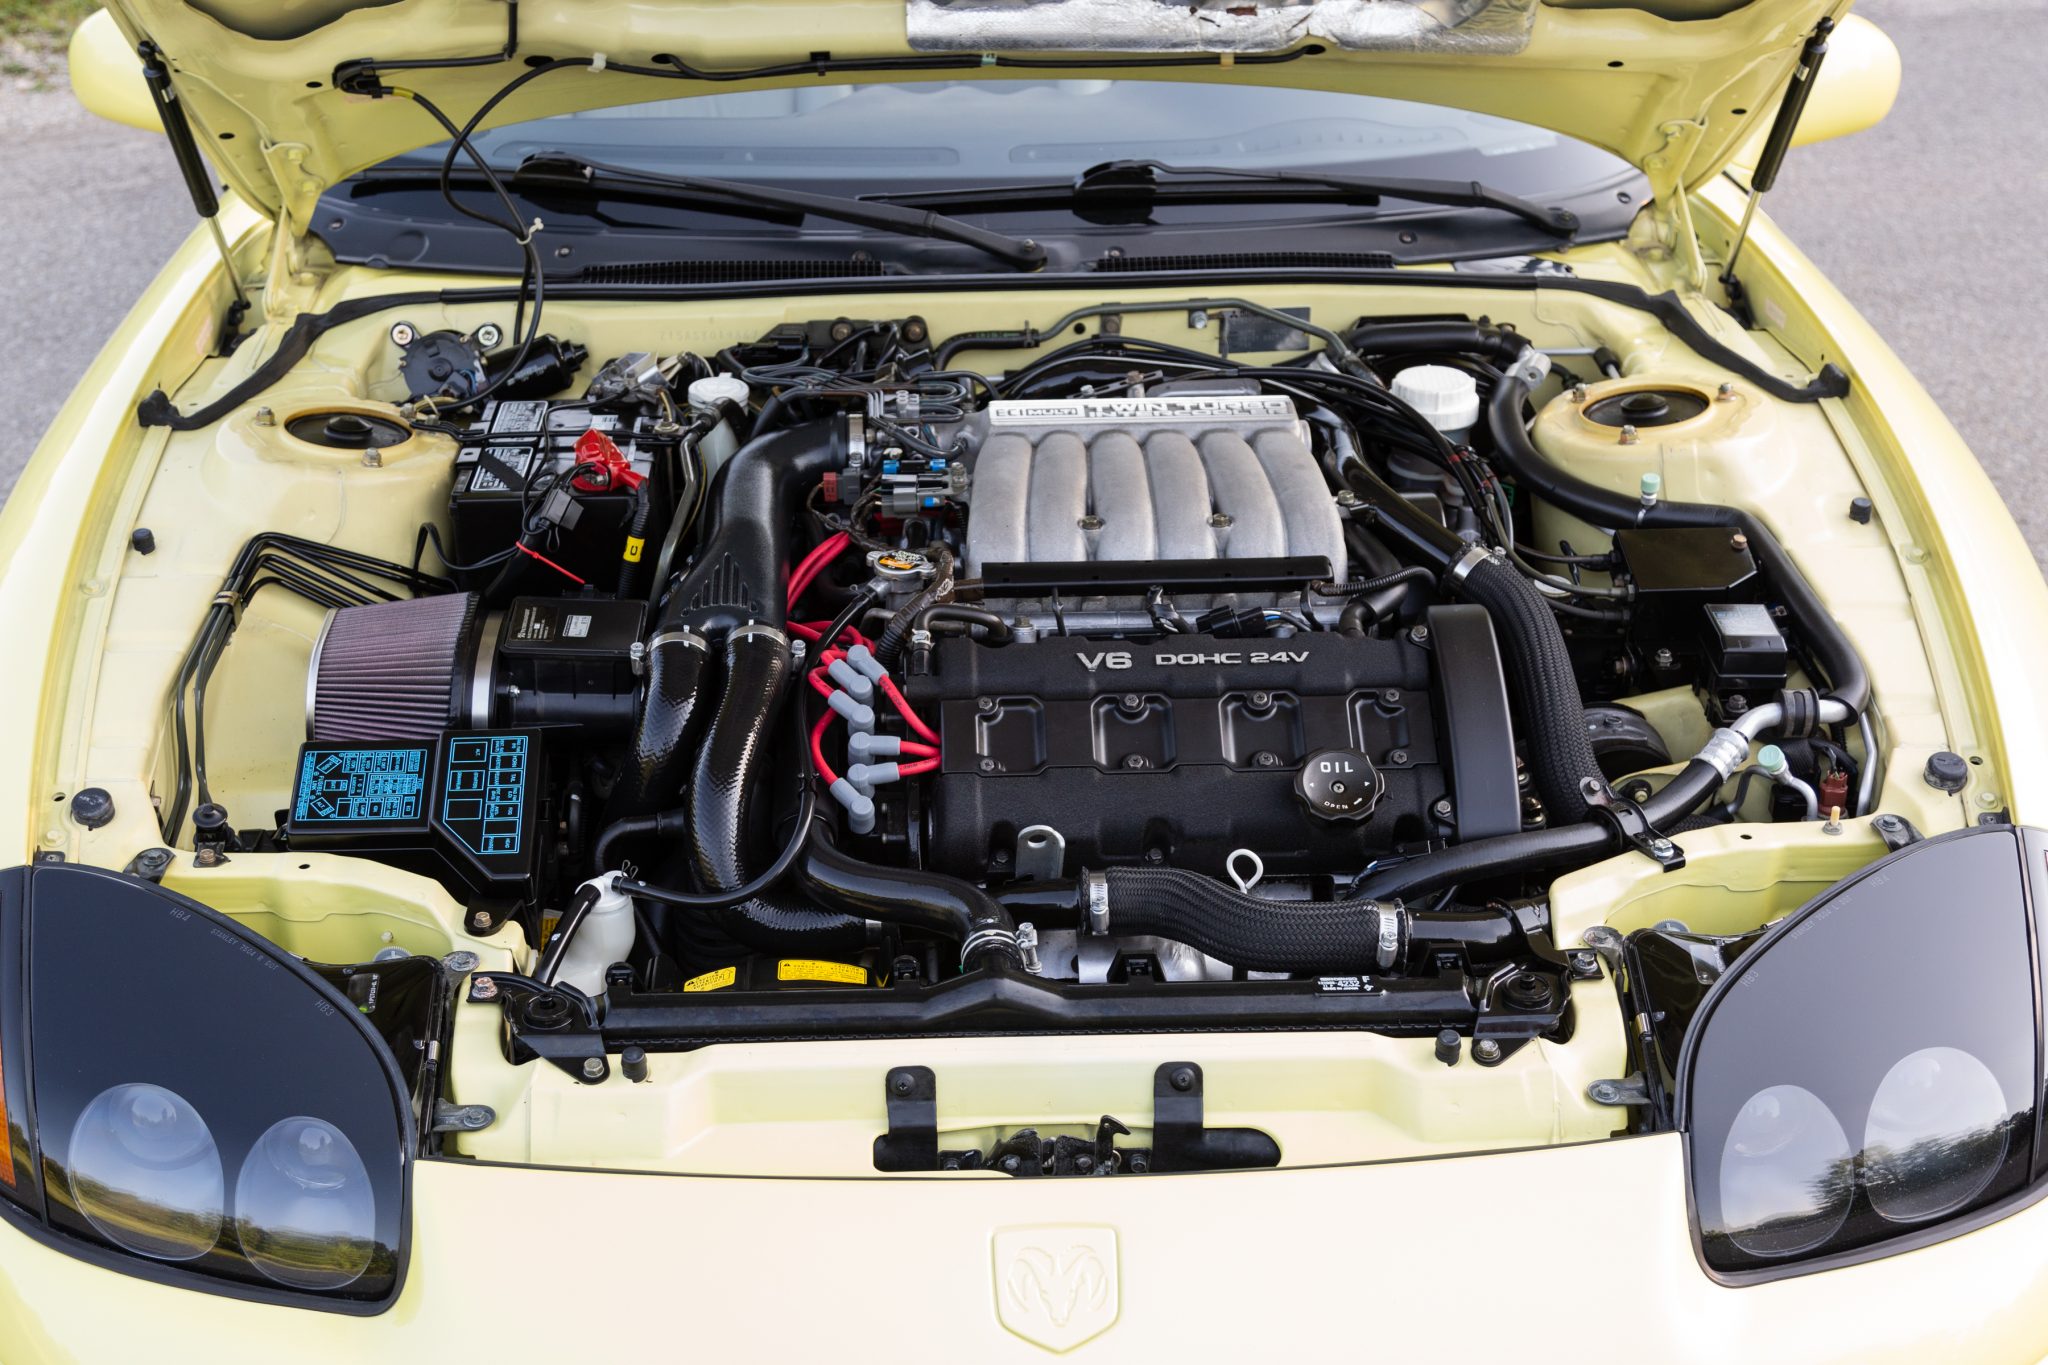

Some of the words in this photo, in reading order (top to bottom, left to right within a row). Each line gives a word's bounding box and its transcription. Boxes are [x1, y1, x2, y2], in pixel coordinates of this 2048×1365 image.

[1089, 400, 1168, 411] TWIN
[1176, 400, 1287, 411] TURBO
[1076, 652, 1133, 671] V6
[1155, 653, 1243, 666] DOHC
[1250, 651, 1310, 665] 24V
[1320, 761, 1354, 774] OIL
[1324, 800, 1349, 810] OPEN
[170, 907, 192, 921] HB4
[210, 928, 238, 946] STANLEY
[315, 999, 335, 1017] HB3
